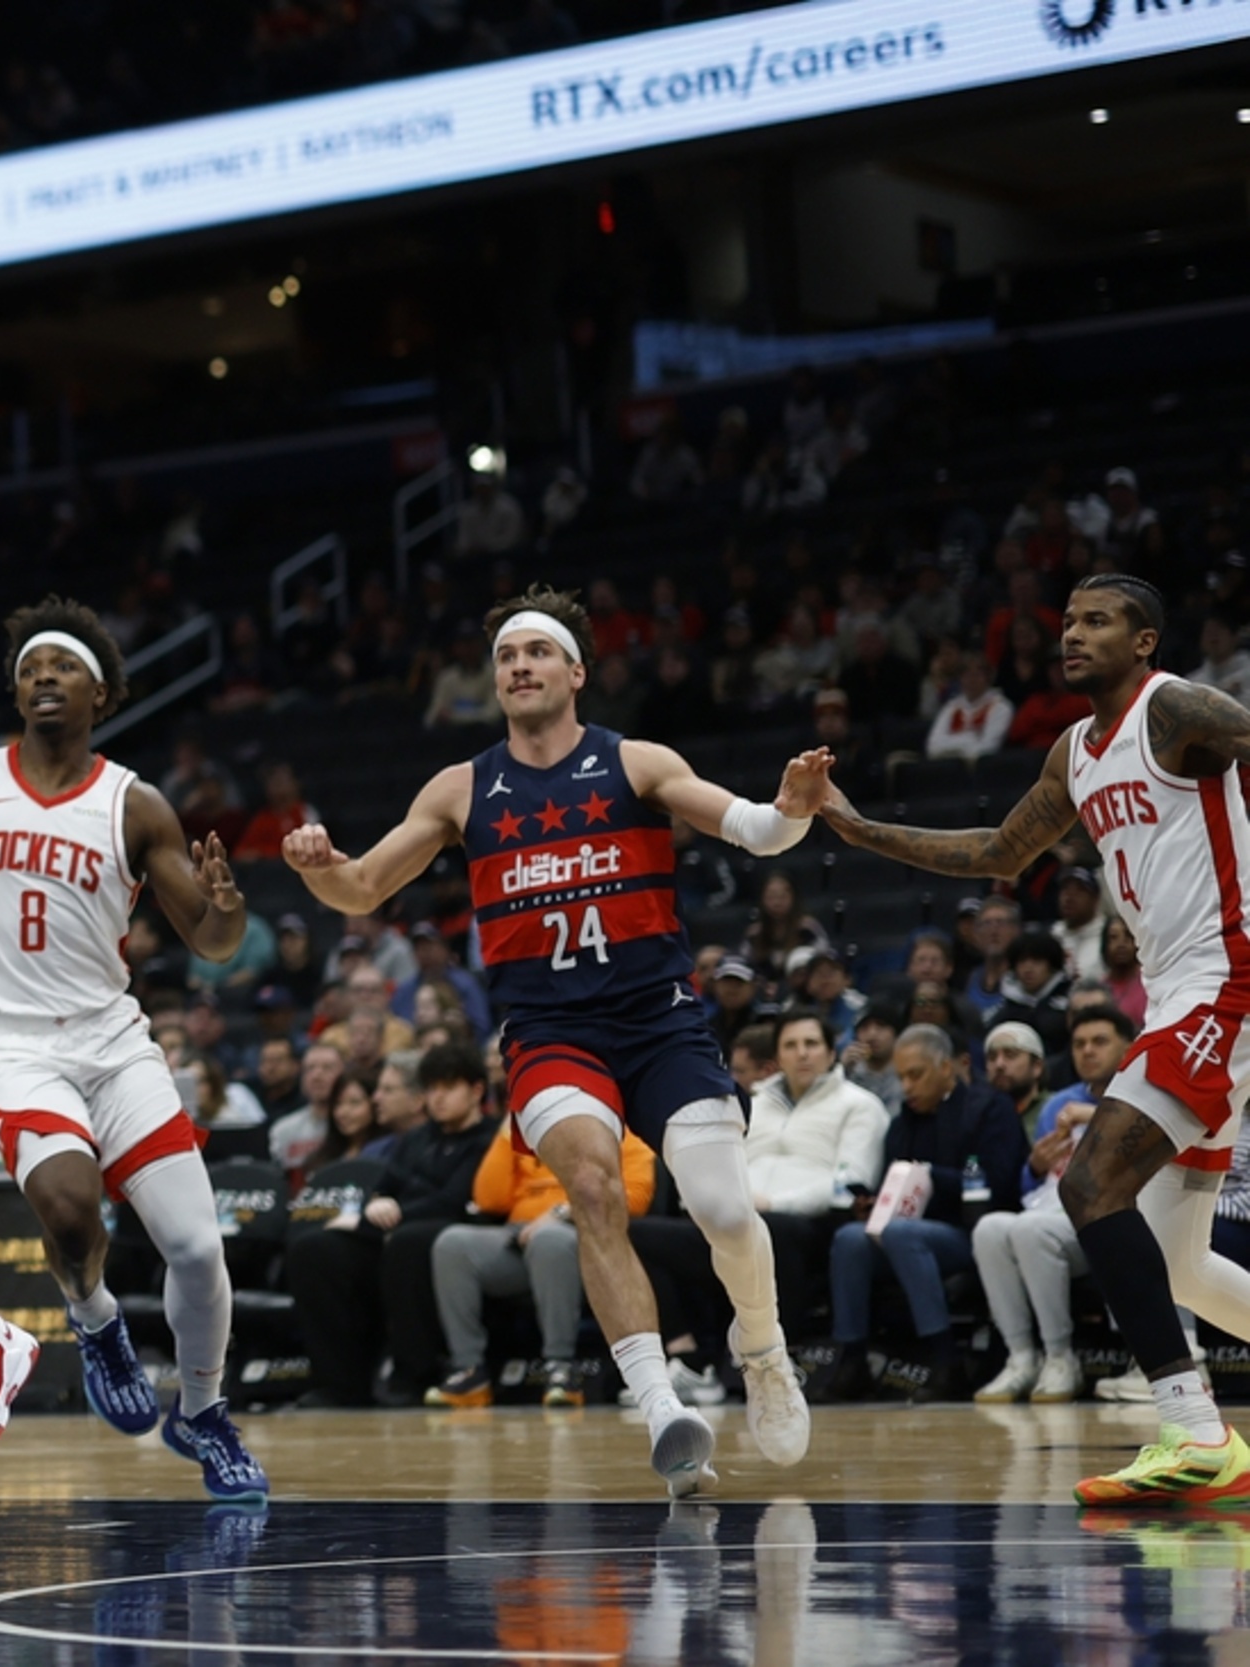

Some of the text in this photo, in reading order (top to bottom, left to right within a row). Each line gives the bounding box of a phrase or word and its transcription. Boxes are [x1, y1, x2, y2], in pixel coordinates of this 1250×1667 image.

[530, 21, 947, 128] RTX.com/careers
[501, 843, 621, 895] district
[1115, 847, 1142, 912] 4
[20, 889, 46, 953] 8
[542, 904, 610, 972] 24
